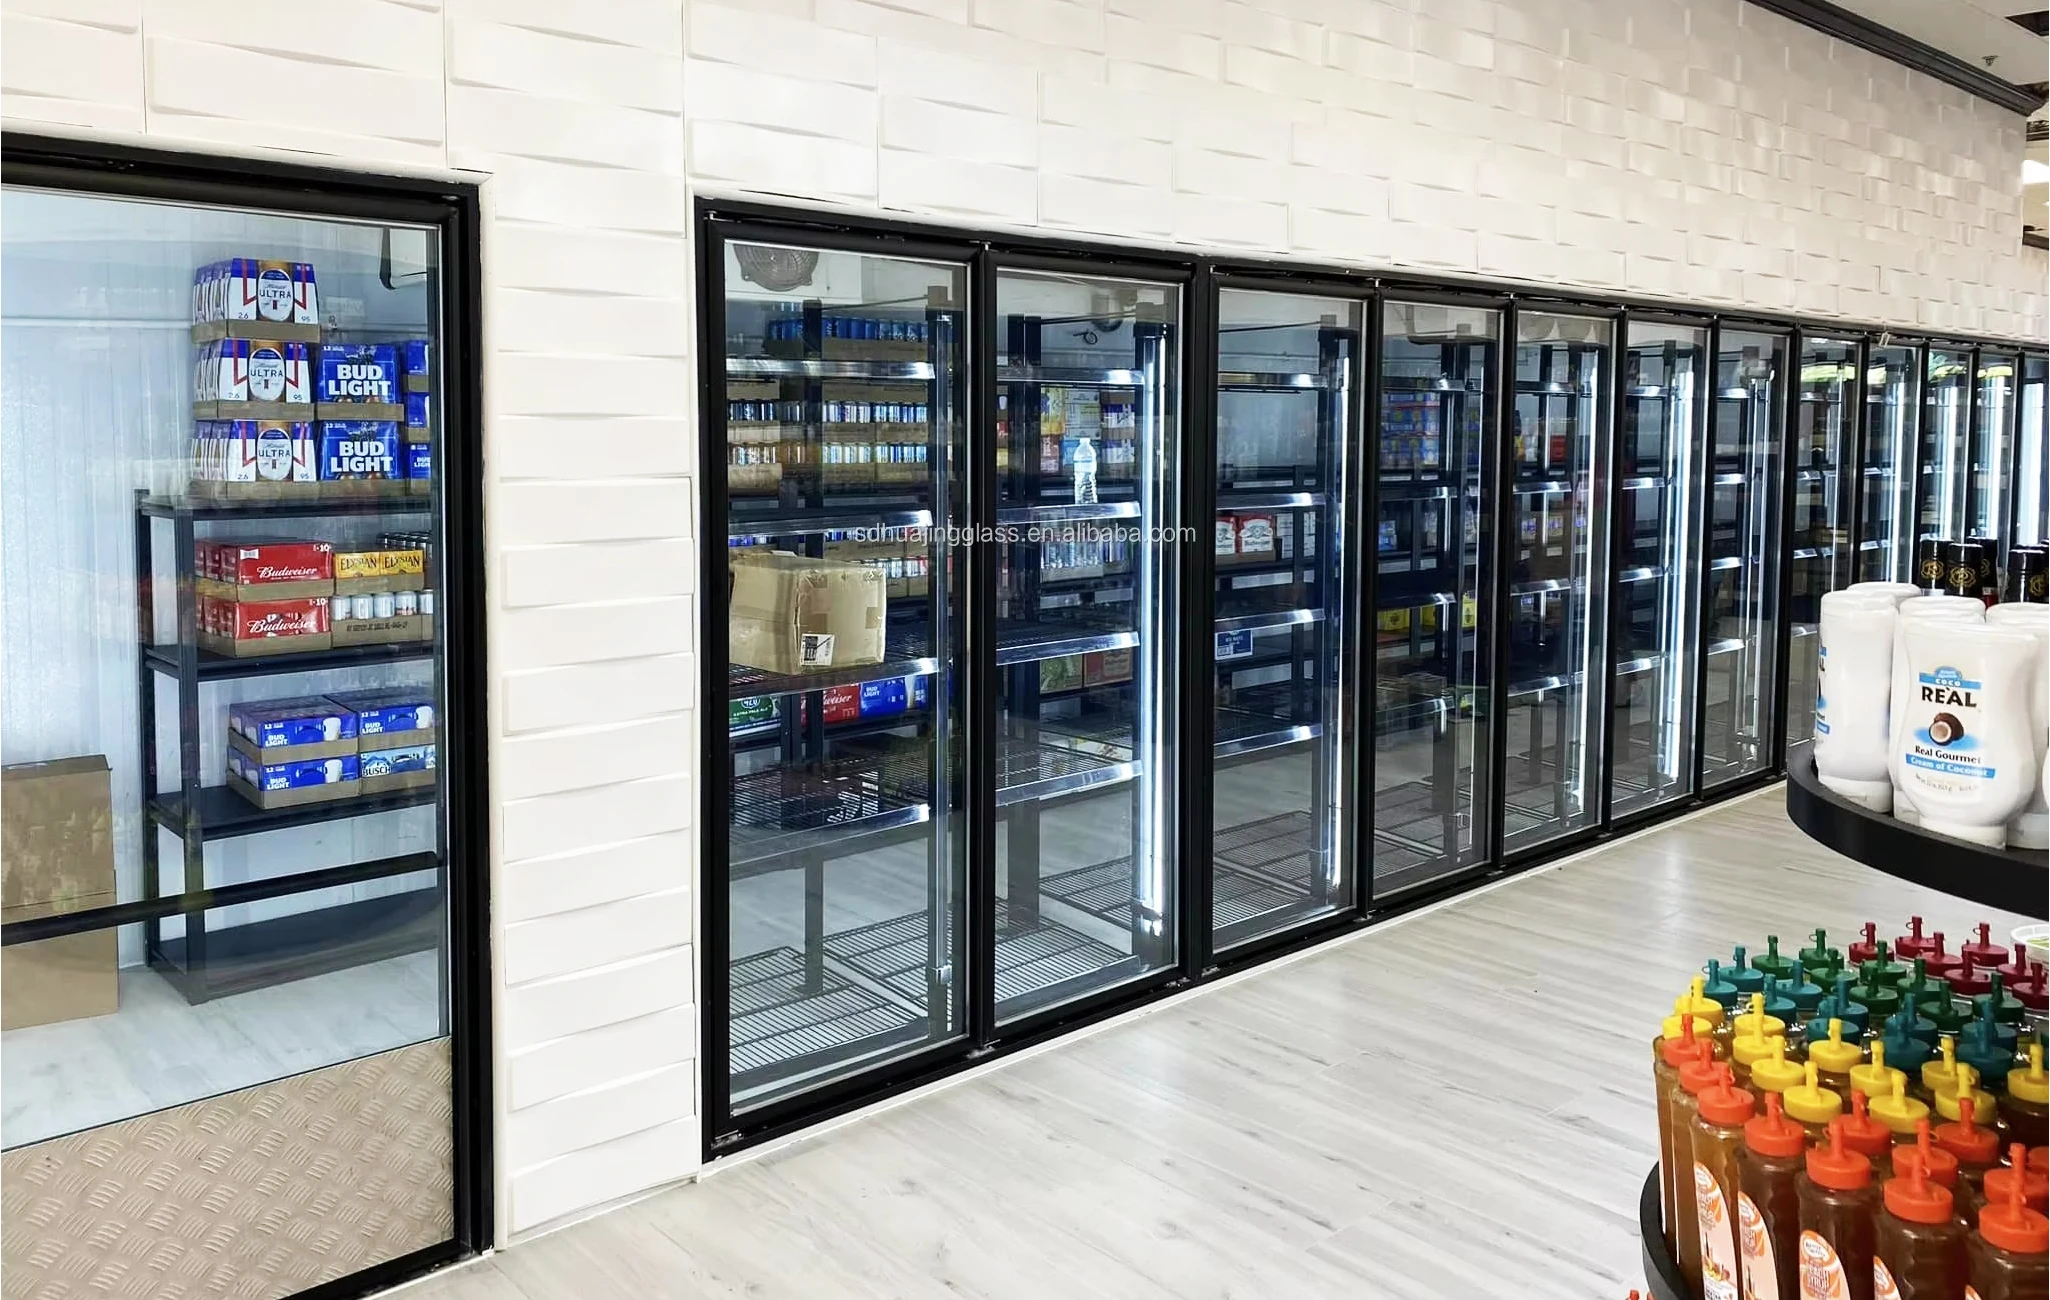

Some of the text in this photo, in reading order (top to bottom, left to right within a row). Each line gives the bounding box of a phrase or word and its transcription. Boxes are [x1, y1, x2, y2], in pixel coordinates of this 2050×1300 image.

[260, 289, 291, 298] ULTRA
[250, 369, 283, 377] ULTRA
[336, 364, 383, 380] BUD
[328, 380, 391, 396] LIGHT
[258, 449, 290, 458] ULTRA
[339, 441, 384, 456] BUD
[330, 456, 393, 472] LIGHT
[256, 566, 318, 579] Budweiser
[247, 618, 318, 634] Budweiser
[1935, 678, 1960, 687] COCO
[823, 694, 852, 706] weiser
[266, 738, 288, 747] LIGHT
[1915, 745, 1981, 764] Real Gourmet
[1910, 756, 1934, 768] Cream
[1936, 762, 1945, 770] of
[266, 782, 290, 790] LIGHT
